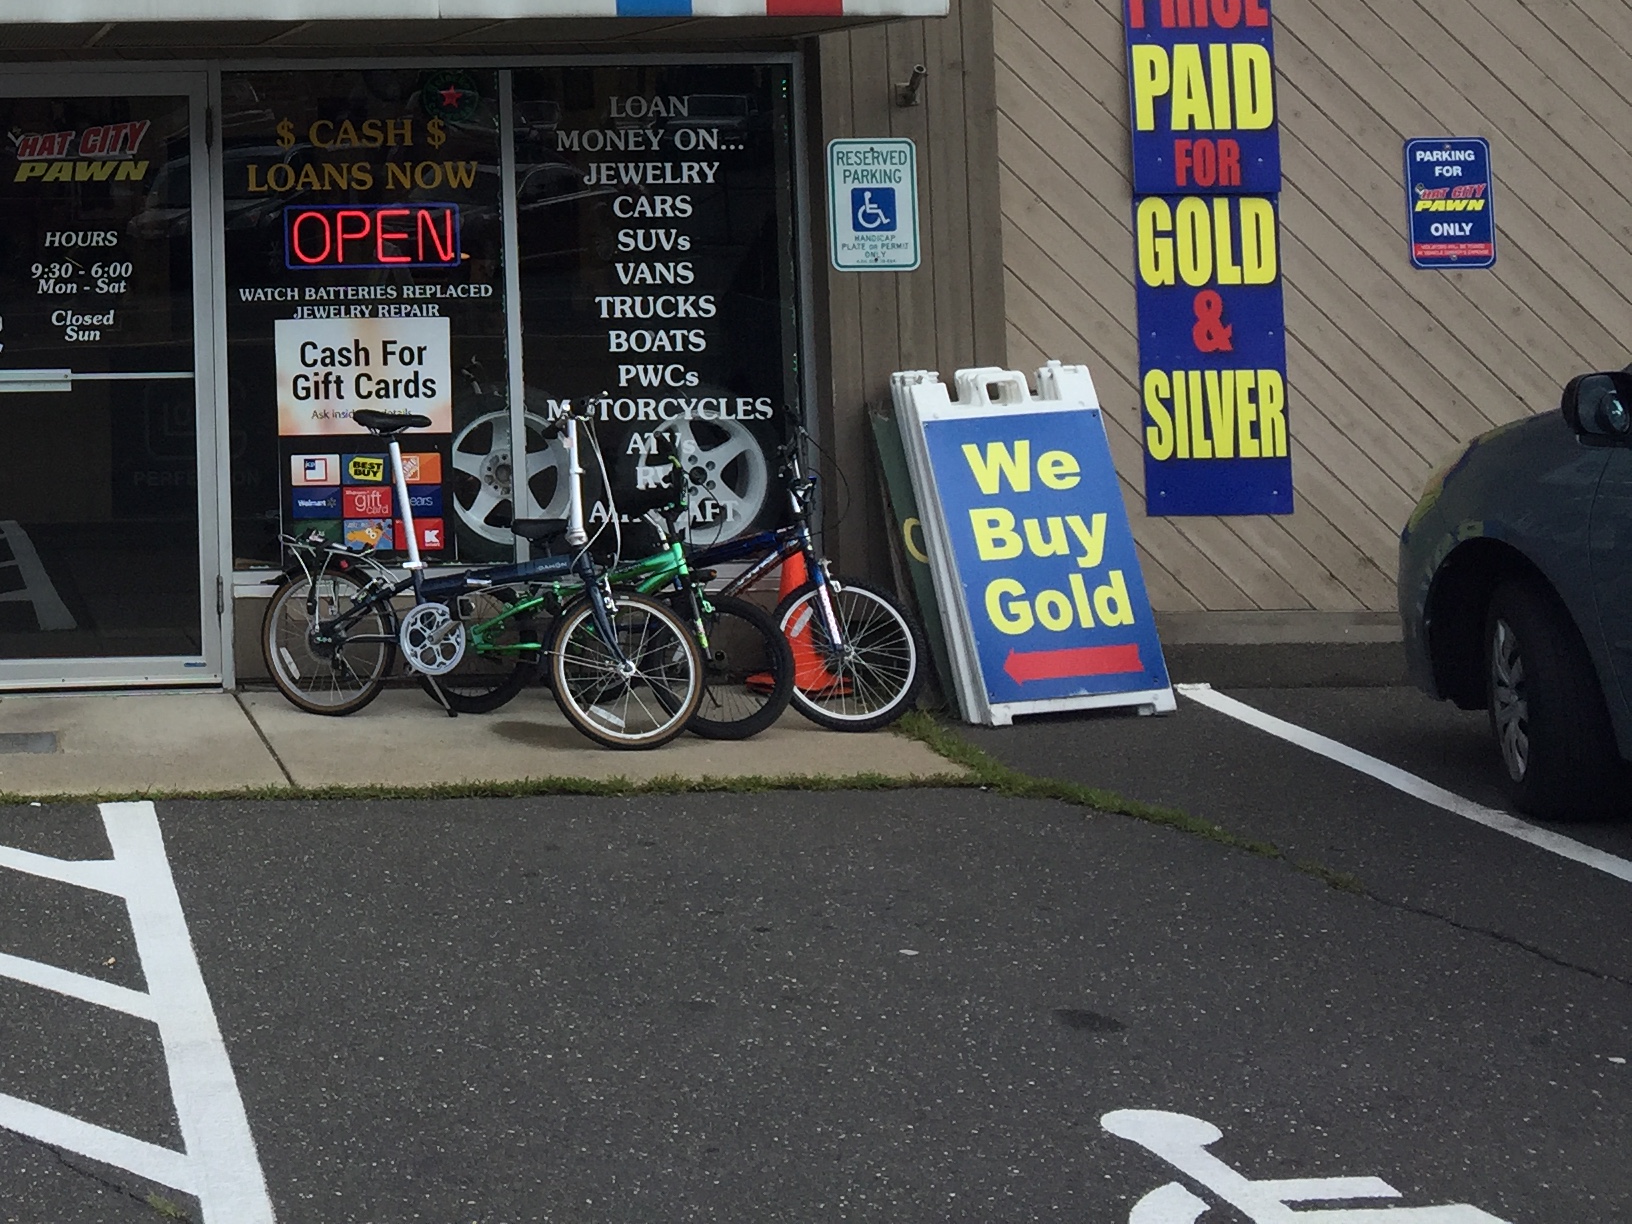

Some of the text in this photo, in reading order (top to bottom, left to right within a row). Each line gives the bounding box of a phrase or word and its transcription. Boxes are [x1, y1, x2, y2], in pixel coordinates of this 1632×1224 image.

[1133, 42, 1273, 132] PAID
[609, 95, 689, 118] LOAN
[17, 120, 151, 160] HAT CITY
[309, 119, 413, 148] CASH
[556, 128, 744, 152] MONEY ON...
[836, 150, 908, 166] RESERVED
[1173, 139, 1242, 187] FOR
[1416, 150, 1475, 162] PARKING
[14, 160, 149, 182] PAWN
[247, 160, 478, 191] LOANS NOW
[583, 162, 719, 186] JEWELRY
[843, 169, 902, 184] PARKING
[1434, 166, 1462, 176] FOR
[1451, 183, 1487, 198] CITY
[612, 196, 693, 219] CARS
[1415, 199, 1485, 212] PAWN
[45, 231, 118, 247] HOURS
[293, 209, 453, 263] OPEN
[617, 229, 691, 252] SUVs
[854, 234, 896, 242] HANDICAP
[1430, 223, 1473, 236] ONLY
[842, 243, 865, 251] PLATE
[1139, 197, 1277, 288] GOLD
[31, 263, 73, 278] 9:30
[91, 262, 133, 278] 6:00
[614, 262, 695, 285] VANS
[37, 279, 77, 294] Mon
[95, 278, 126, 293] Sat
[239, 284, 493, 302] WATCH BATTERIES REPLACED
[51, 310, 115, 326] Closed
[293, 304, 440, 319] JEWELRY REPAIR
[595, 295, 717, 319] TRUCKS
[1192, 290, 1233, 354] &
[65, 326, 100, 341] Sun
[608, 330, 706, 353] BOATS
[299, 339, 428, 368] Cash For
[292, 370, 437, 401] Gift Cards
[618, 364, 699, 388] PWCs
[311, 410, 329, 419] Ask
[332, 409, 355, 419] insid
[546, 397, 774, 422] MTORCYCLES
[1146, 368, 1288, 460] SILVER
[353, 462, 383, 471] BEST
[354, 469, 381, 477] BUY
[961, 439, 1082, 496] We
[297, 499, 327, 507] Walmart
[355, 490, 382, 512] gift
[366, 504, 389, 514] card
[410, 495, 434, 506] ears
[969, 508, 1109, 573] Buy
[984, 573, 1135, 637] Gold
